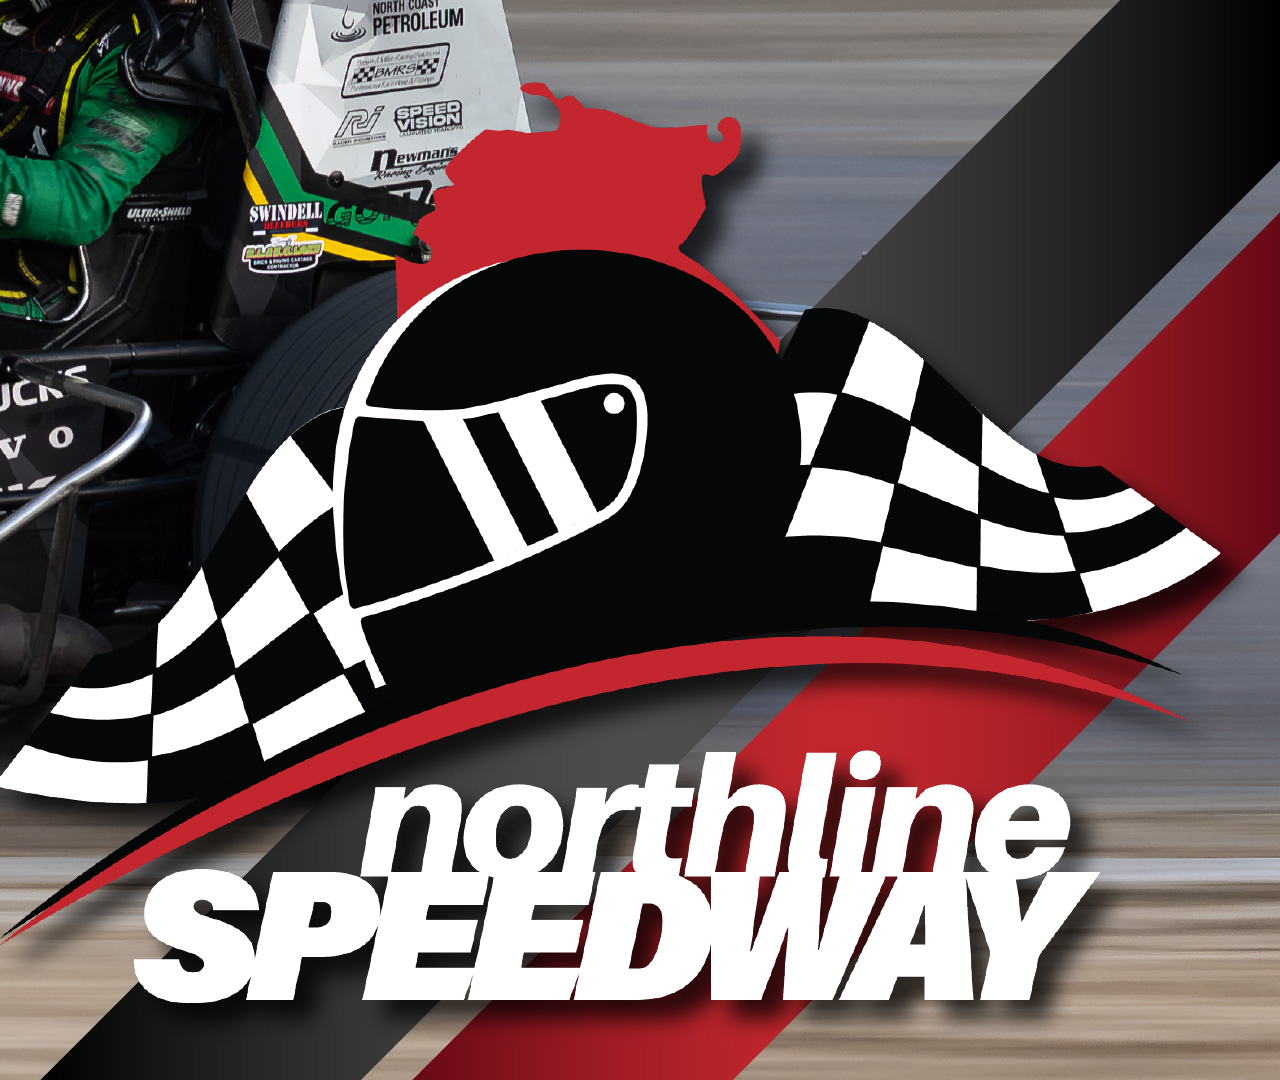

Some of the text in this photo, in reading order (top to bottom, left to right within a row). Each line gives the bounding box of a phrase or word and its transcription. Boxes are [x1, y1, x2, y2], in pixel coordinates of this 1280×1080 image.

[372, 0, 406, 15] NORTH
[372, 7, 465, 37] PETROLEUM
[374, 63, 417, 79] BMRS
[396, 101, 461, 120] SPEED
[397, 112, 461, 132] VISION
[414, 162, 448, 176] Engin
[249, 201, 323, 223] SWINDELL
